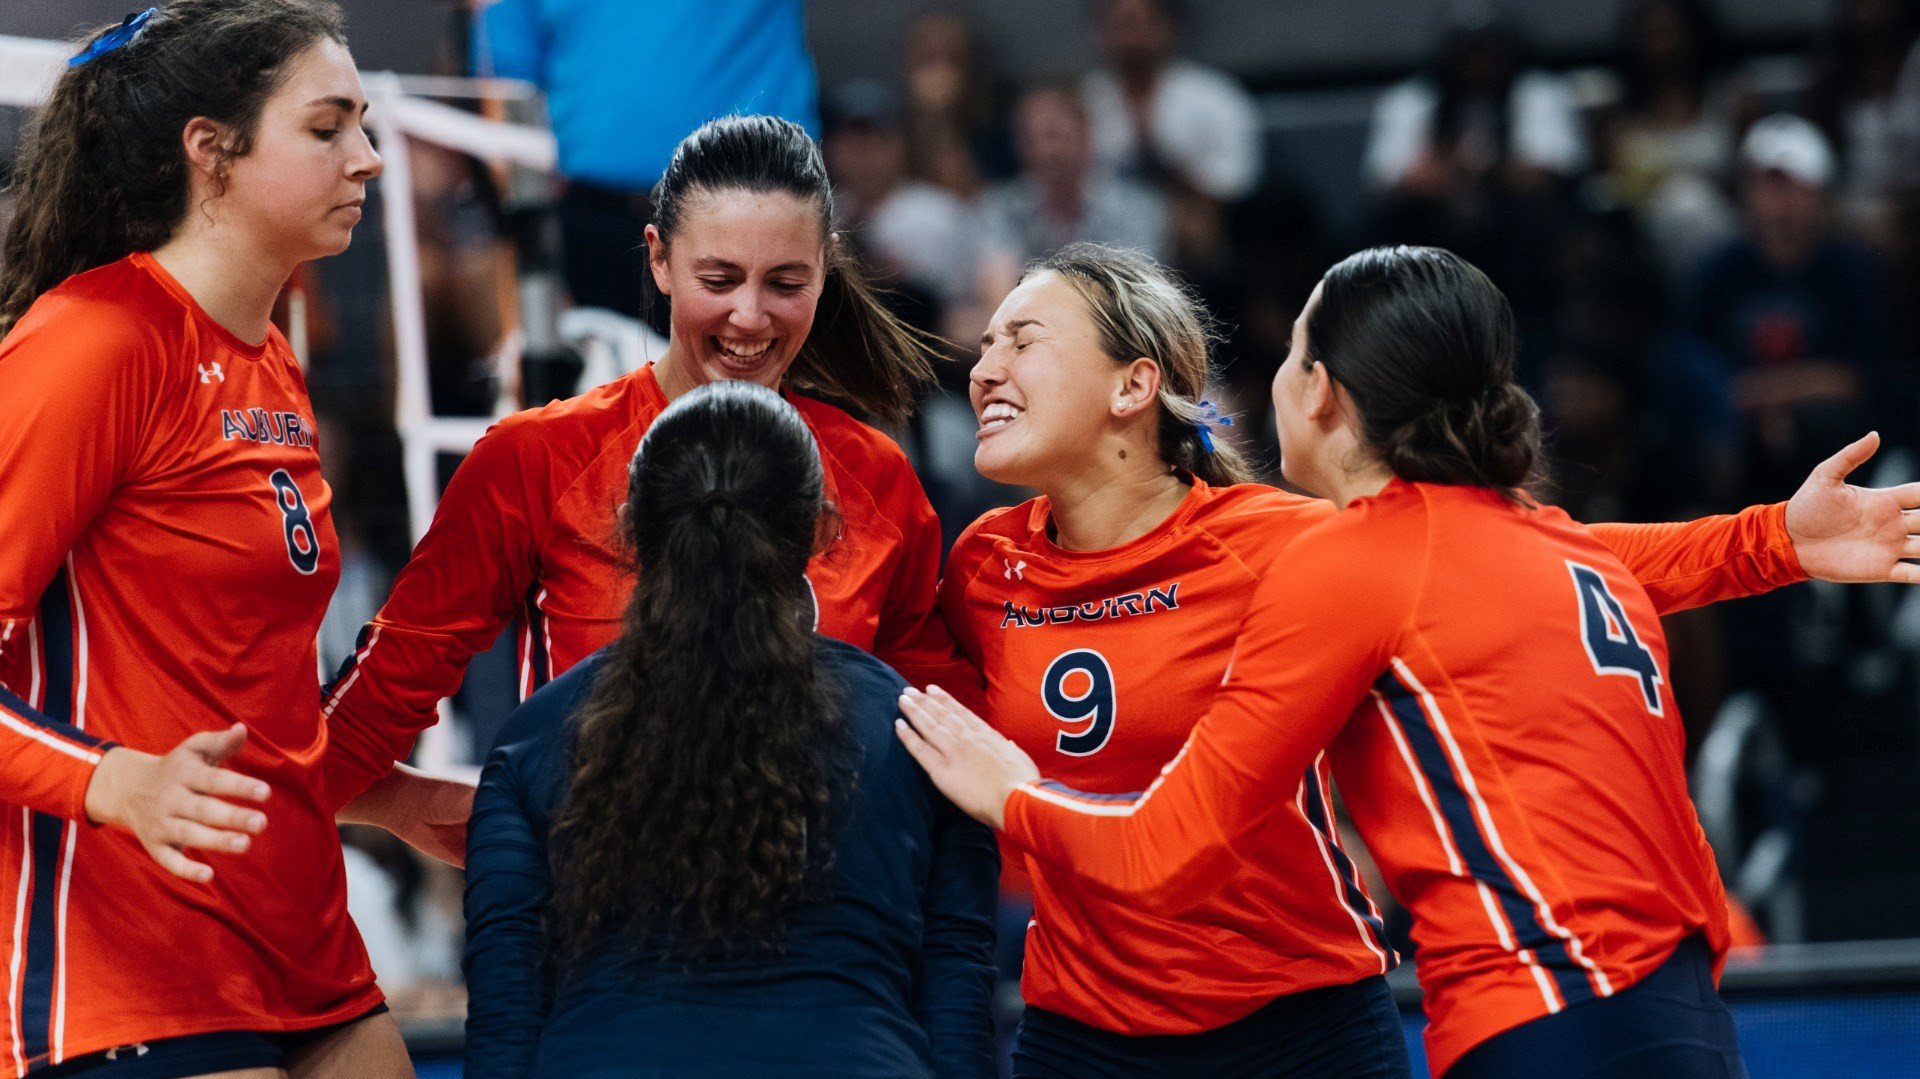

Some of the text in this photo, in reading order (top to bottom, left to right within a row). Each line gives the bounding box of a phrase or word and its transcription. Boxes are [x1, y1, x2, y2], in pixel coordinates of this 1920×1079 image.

[269, 468, 320, 575] 8
[1000, 582, 1181, 629] AUBURN
[1564, 559, 1664, 718] 4
[1040, 648, 1117, 757] 9
